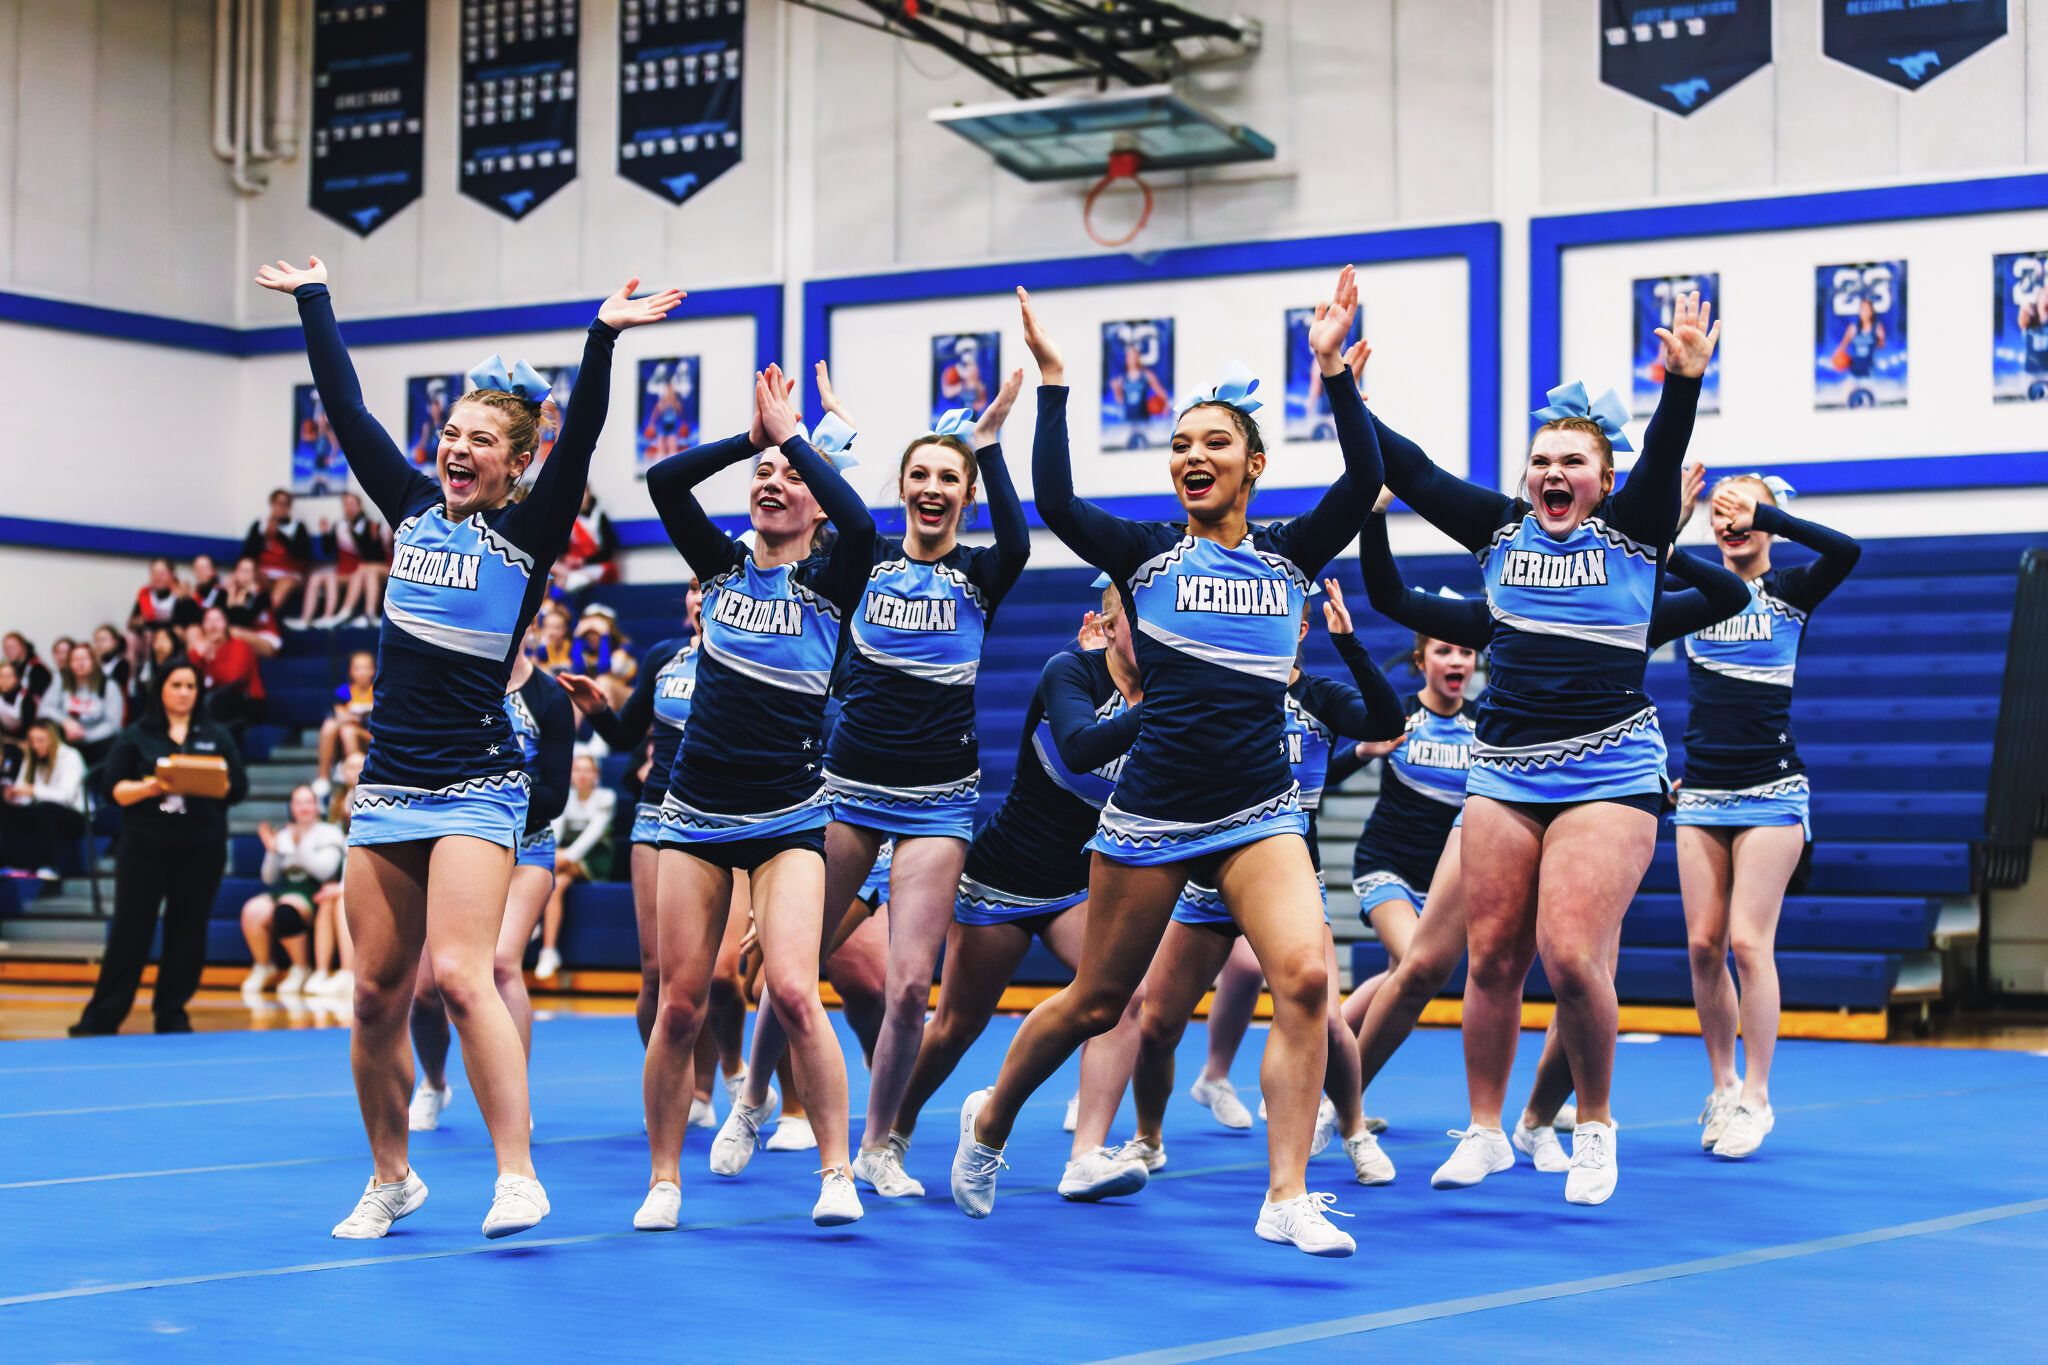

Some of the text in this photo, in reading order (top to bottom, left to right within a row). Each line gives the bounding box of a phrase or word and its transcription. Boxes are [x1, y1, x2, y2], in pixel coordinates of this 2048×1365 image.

[1833, 267, 1891, 315] 23
[646, 361, 692, 399] 44
[390, 543, 481, 591] MERIDIAN
[1500, 548, 1608, 588] MERIDIAN
[712, 588, 803, 636] MERIDIAN
[864, 591, 956, 631] MERIDIAN
[1175, 575, 1289, 616] MERIDIAN
[1406, 739, 1473, 770] MERIDIA
